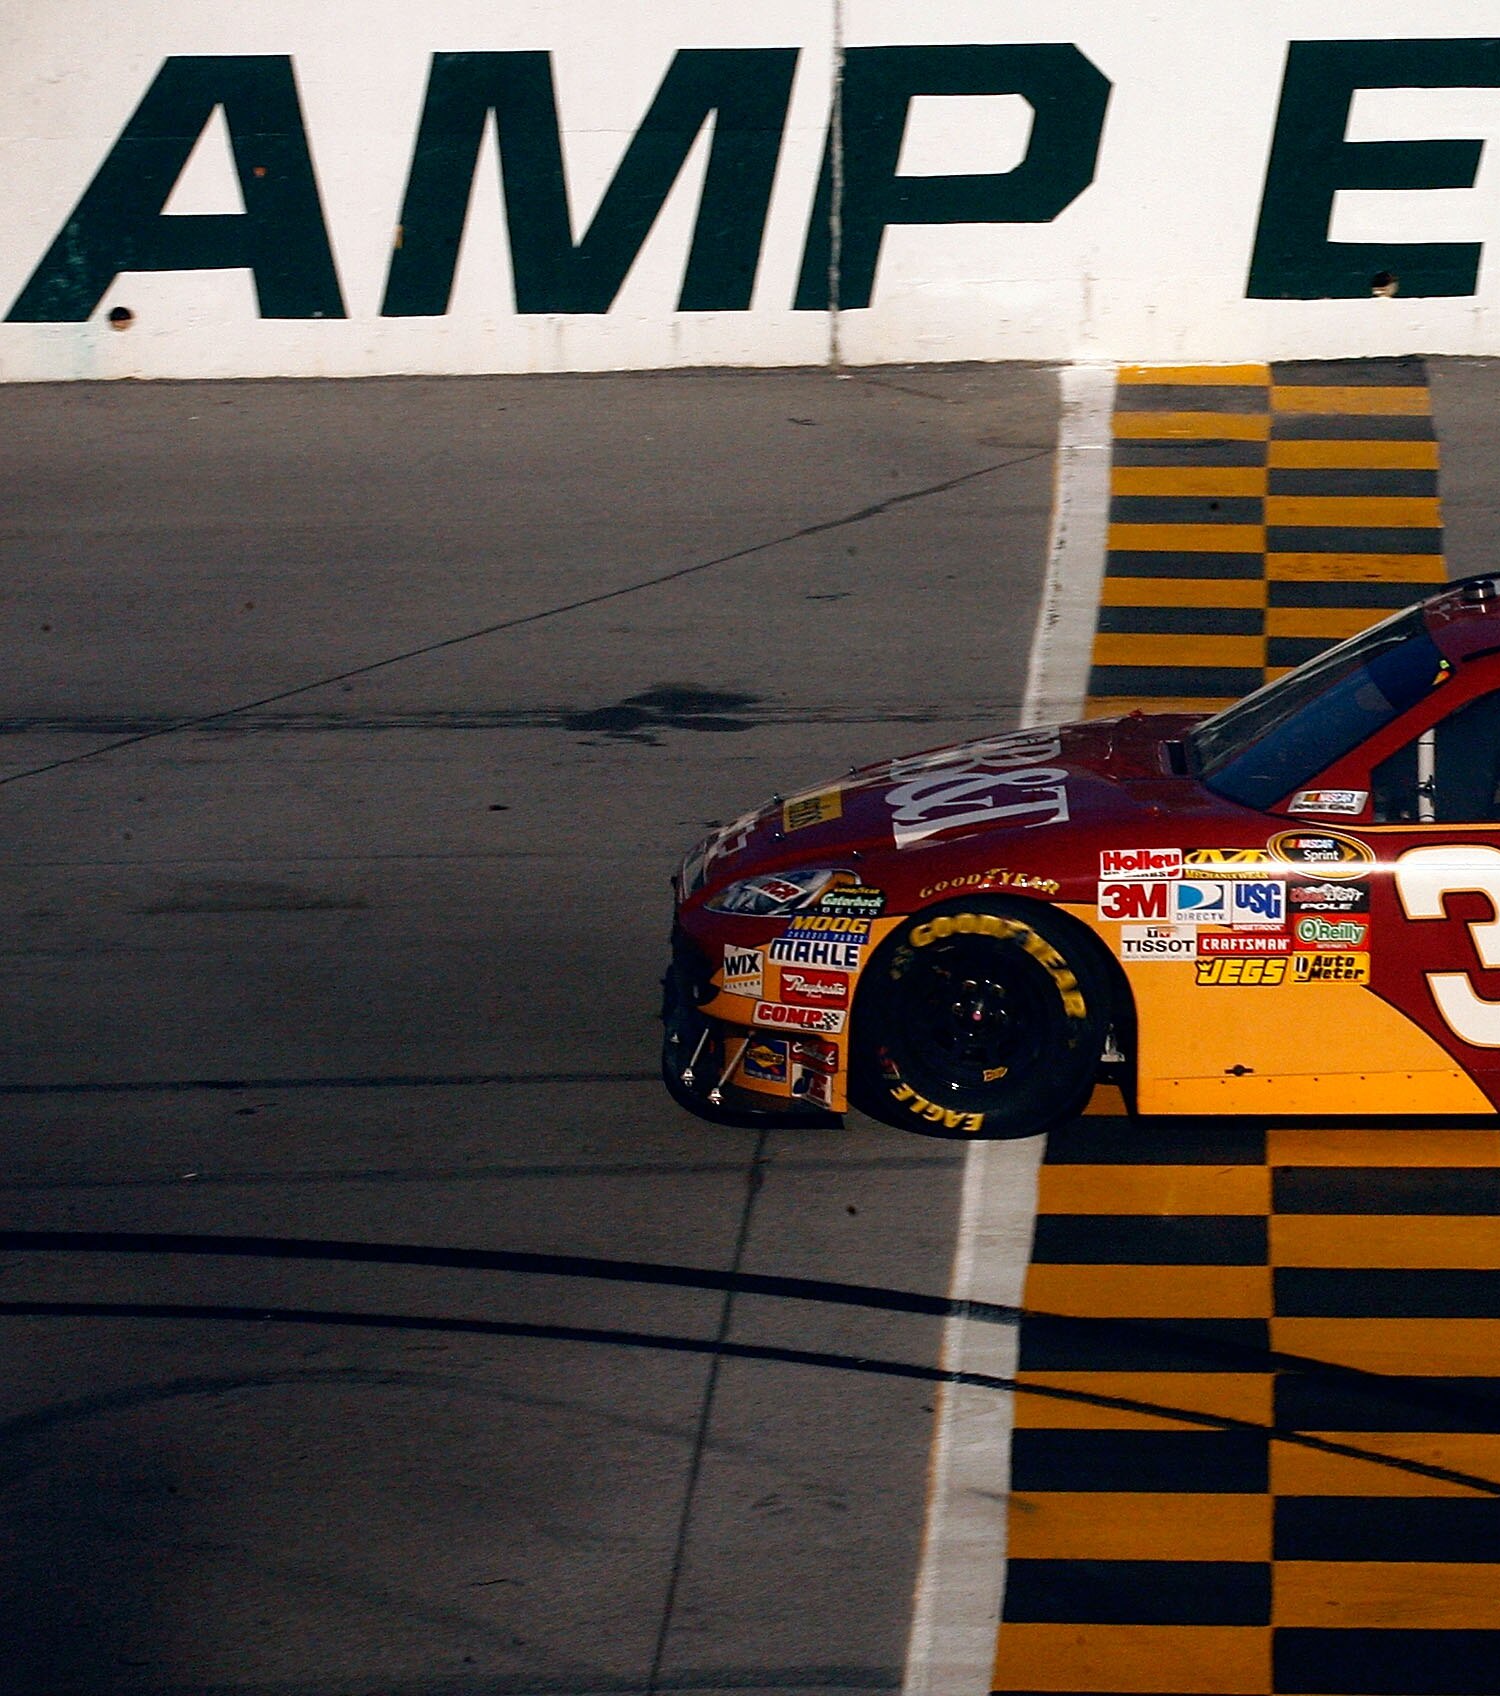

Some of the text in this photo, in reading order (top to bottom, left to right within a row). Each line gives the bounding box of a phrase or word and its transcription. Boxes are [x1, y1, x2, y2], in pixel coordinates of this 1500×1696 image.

[3, 42, 1113, 323] AMP
[1102, 851, 1180, 877] Holley
[1303, 849, 1340, 863] Sprint
[822, 906, 878, 916] BELTS
[1101, 883, 1168, 919] 3M
[1235, 883, 1282, 919] USG
[1300, 902, 1354, 911] POLE
[788, 915, 872, 934] MOOG
[1177, 912, 1225, 921] DIRECTV
[1299, 918, 1364, 944] O'Reilly
[769, 939, 859, 968] MAHLE
[1122, 940, 1196, 953] TISSOT
[1203, 938, 1287, 951] CRAFTSMAN
[724, 952, 761, 977] WIX
[1196, 957, 1286, 985] JEGS
[757, 1003, 823, 1024] COMP
[889, 1082, 985, 1132] EAGLE
